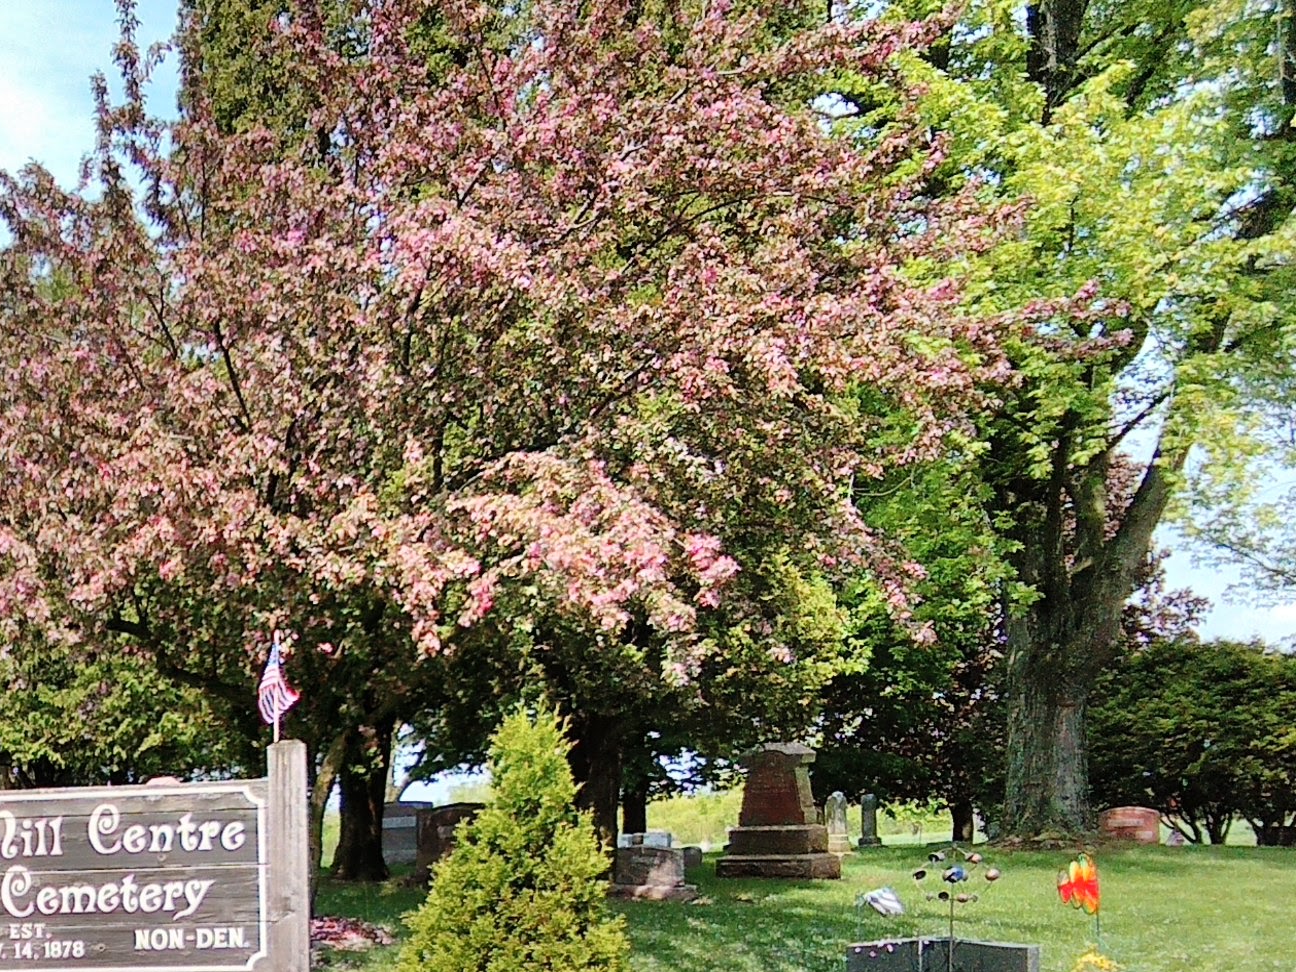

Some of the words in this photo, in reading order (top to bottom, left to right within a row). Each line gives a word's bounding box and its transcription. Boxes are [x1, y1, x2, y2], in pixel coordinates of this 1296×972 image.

[88, 804, 246, 854] Centre
[1, 865, 216, 921] Cemetery
[9, 923, 52, 940] EST.
[134, 927, 250, 950] NON-DEN.
[44, 941, 85, 959] 1878
